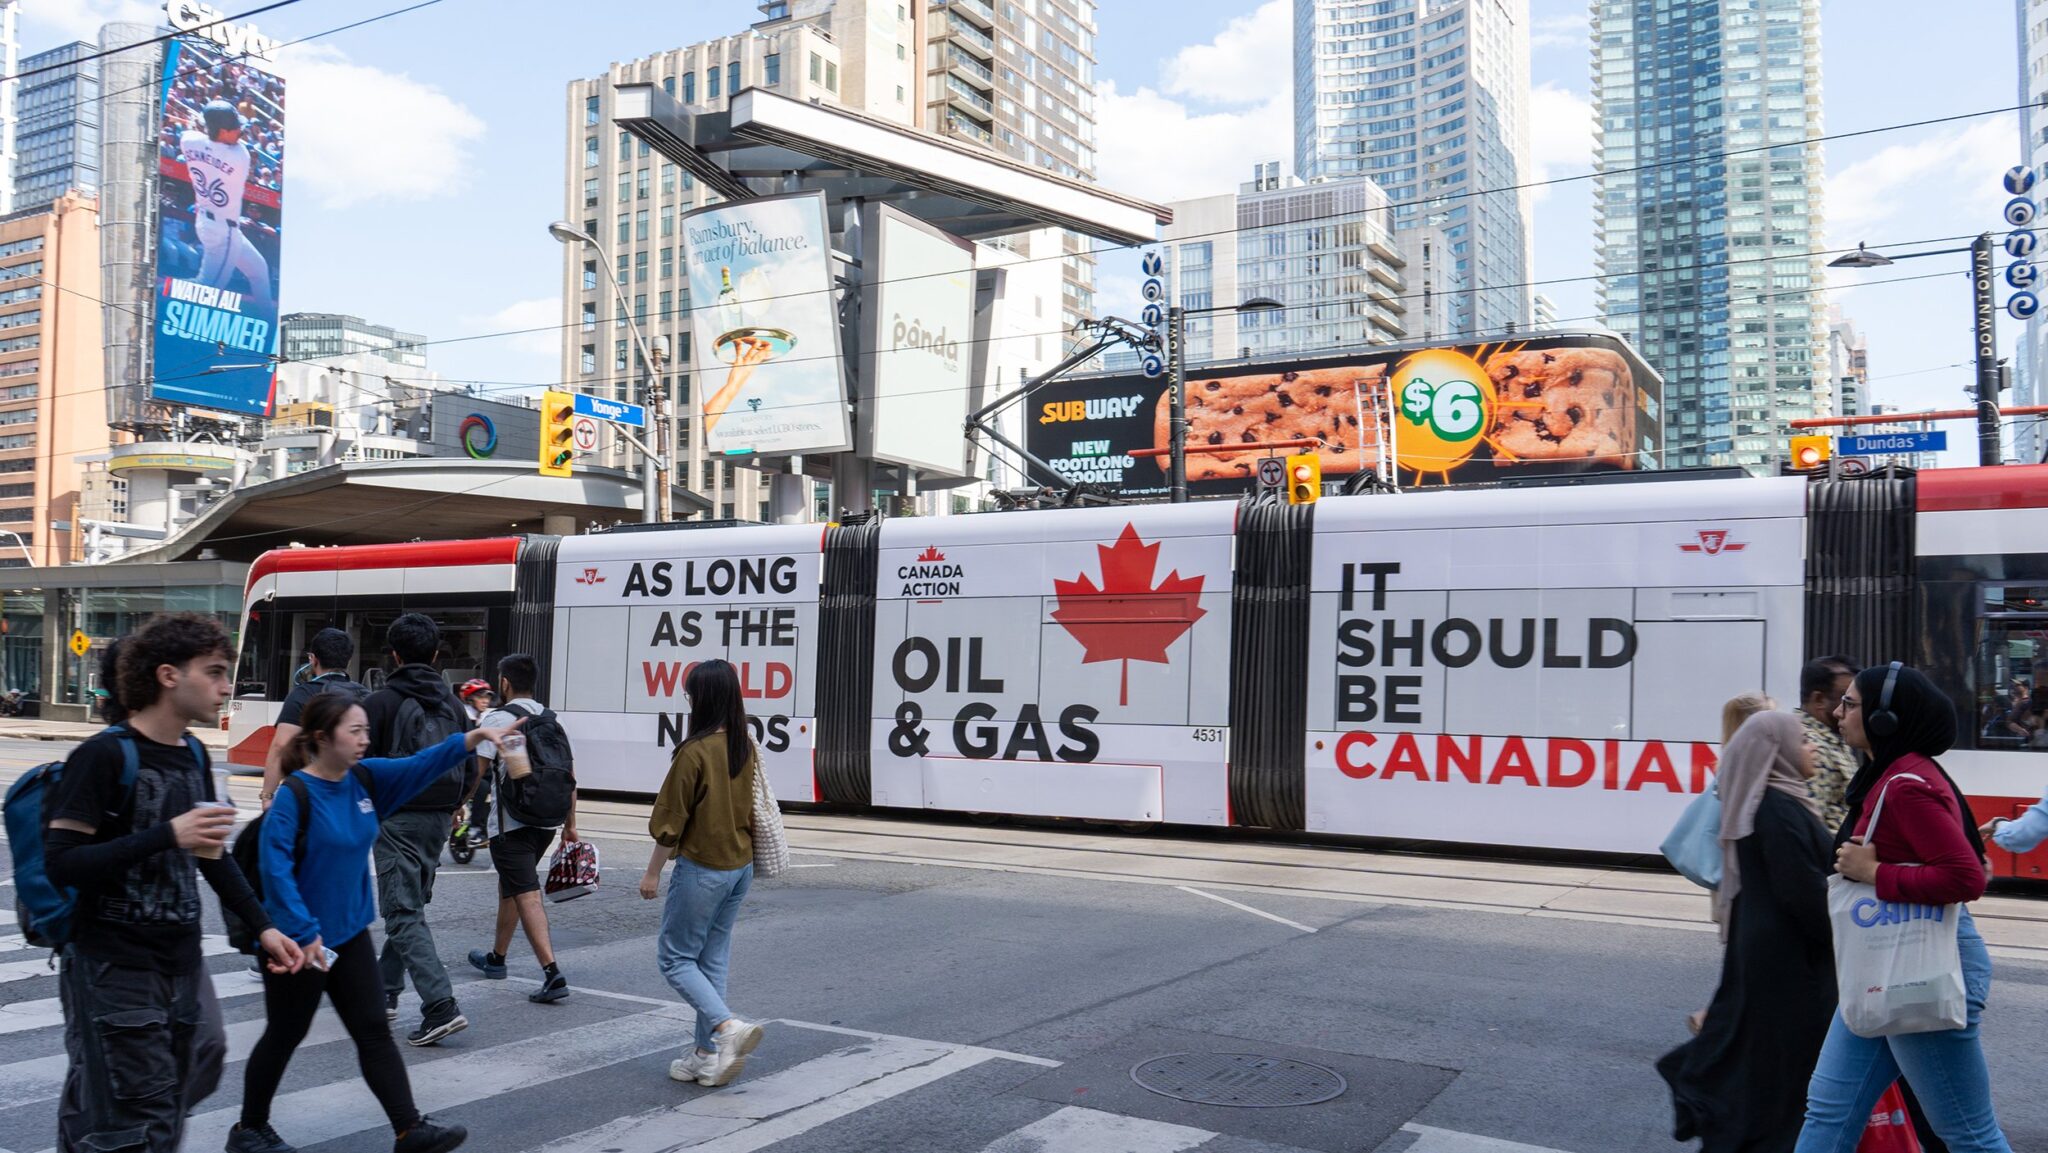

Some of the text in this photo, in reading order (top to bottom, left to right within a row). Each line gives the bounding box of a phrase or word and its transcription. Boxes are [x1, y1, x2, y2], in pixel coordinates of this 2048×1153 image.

[185, 148, 235, 176] SCHNEIDER
[190, 166, 229, 208] 36
[704, 246, 721, 263] act
[722, 238, 738, 263] of
[738, 233, 808, 257] balance.
[2004, 166, 2039, 320] Yonge
[170, 278, 242, 313] WATCH ALL
[1142, 252, 1162, 378] Yone
[1976, 251, 1993, 357] DOWNTOWN
[161, 300, 268, 353] SUMMER
[1169, 315, 1179, 405] DOWNTOWN
[591, 398, 622, 420] Yonge
[1039, 394, 1144, 425] SUBWAY
[1402, 378, 1483, 436] $6
[1072, 440, 1110, 455] NEW
[1857, 436, 1915, 451] Dundas
[1049, 455, 1135, 472] FOOTLONG
[622, 556, 798, 597] AS LONG
[897, 564, 964, 580] CANADA
[901, 582, 960, 597] ACTION
[1340, 562, 1401, 611] IT
[650, 609, 796, 647] AS THE
[1336, 617, 1638, 669] SHOULD
[642, 661, 793, 699] WLD
[892, 636, 1004, 694] OIL
[1337, 674, 1423, 724] BE
[888, 701, 1100, 764] & GAS
[1192, 728, 1223, 742] 4531
